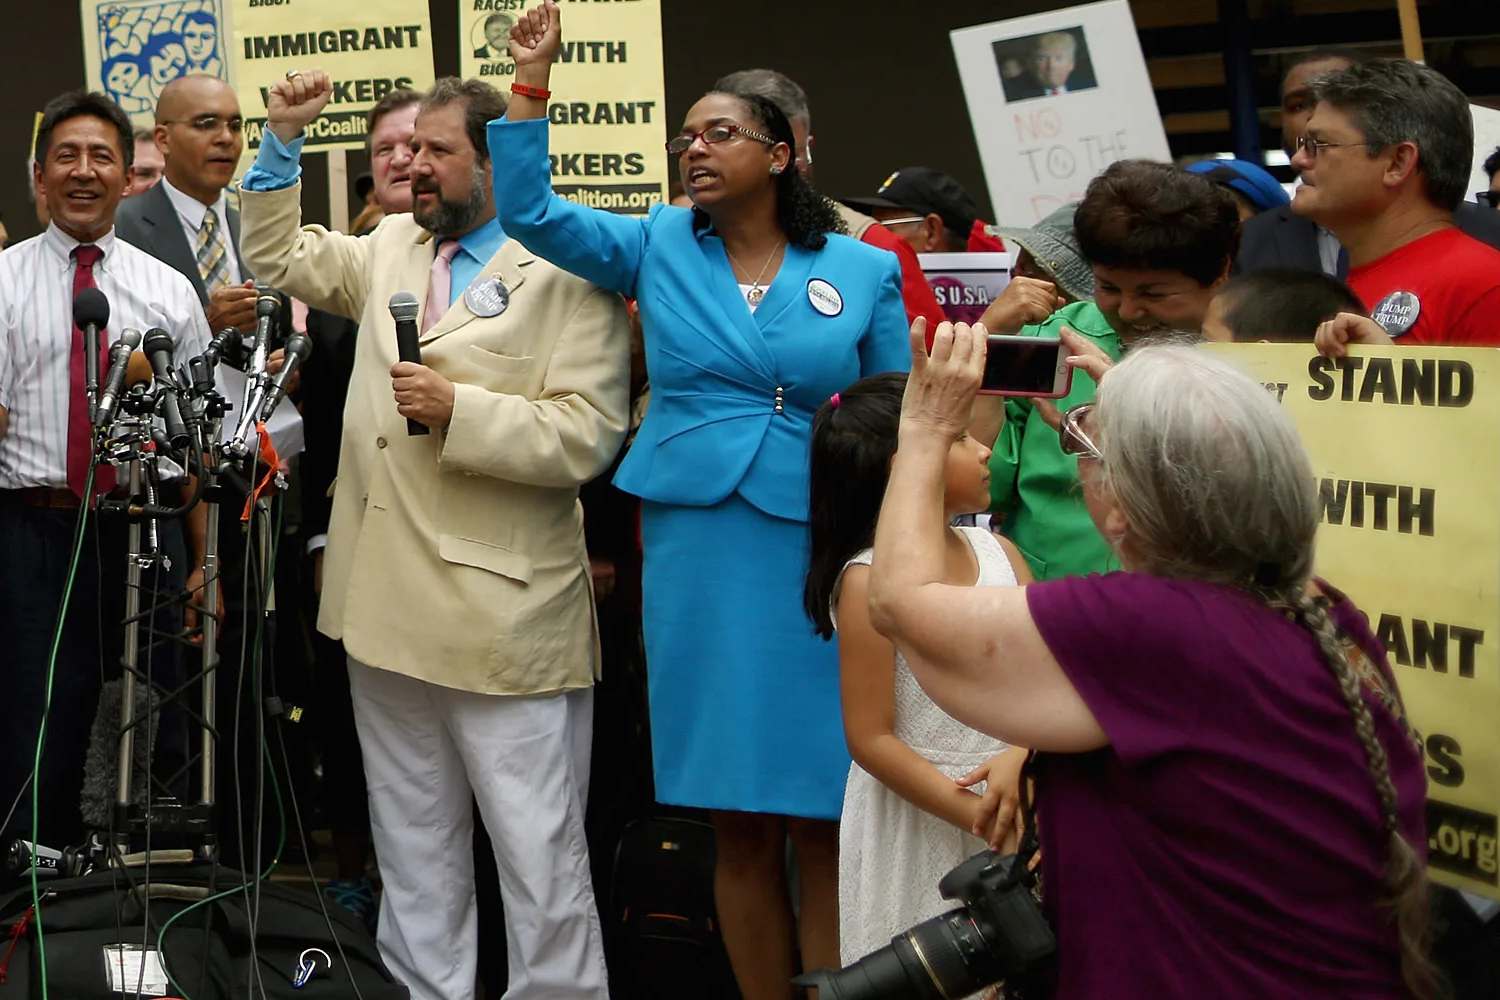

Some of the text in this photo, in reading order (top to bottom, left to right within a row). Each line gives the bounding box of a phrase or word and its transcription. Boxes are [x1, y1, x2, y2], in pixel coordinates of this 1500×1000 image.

[243, 25, 421, 60] IMMIGRANT
[479, 63, 516, 76] BIGO
[549, 101, 655, 124] GRANT
[1014, 107, 1062, 143] NO
[1019, 144, 1076, 184] TO
[1375, 313, 1409, 325] TRUMP
[1381, 303, 1411, 315] DUMP
[1308, 355, 1475, 408] STAND
[1316, 477, 1436, 537] WITH
